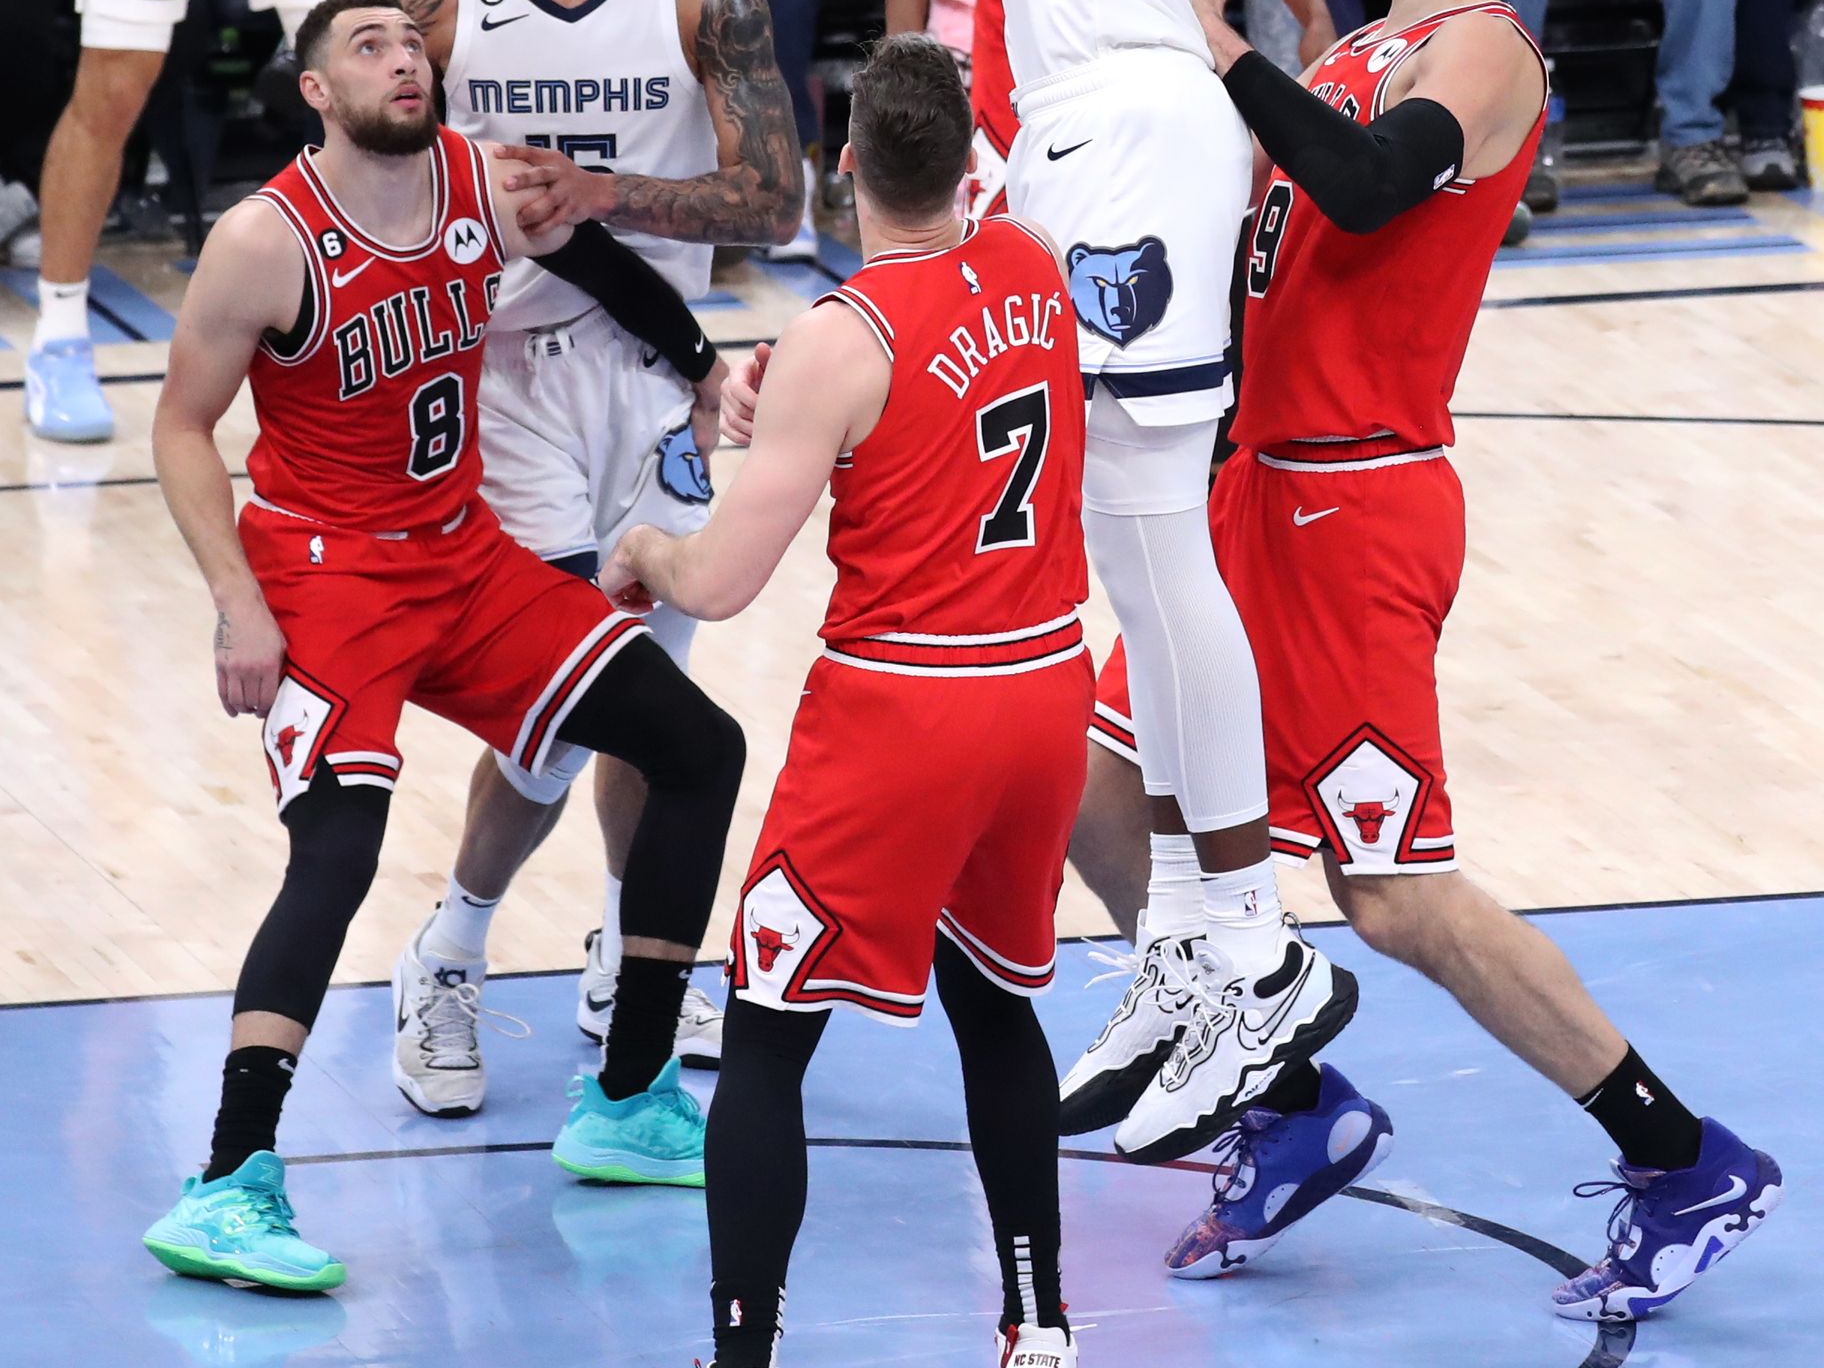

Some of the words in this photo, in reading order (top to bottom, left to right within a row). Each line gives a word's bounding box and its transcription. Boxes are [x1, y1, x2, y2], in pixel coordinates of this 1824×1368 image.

[468, 76, 670, 114] MEMPHIS
[323, 231, 342, 256] 6
[1248, 179, 1293, 299] 9
[927, 290, 1062, 400] DRAGIĆ
[406, 372, 465, 481] 8
[974, 379, 1050, 555] 7
[1027, 1353, 1062, 1368] STATE
